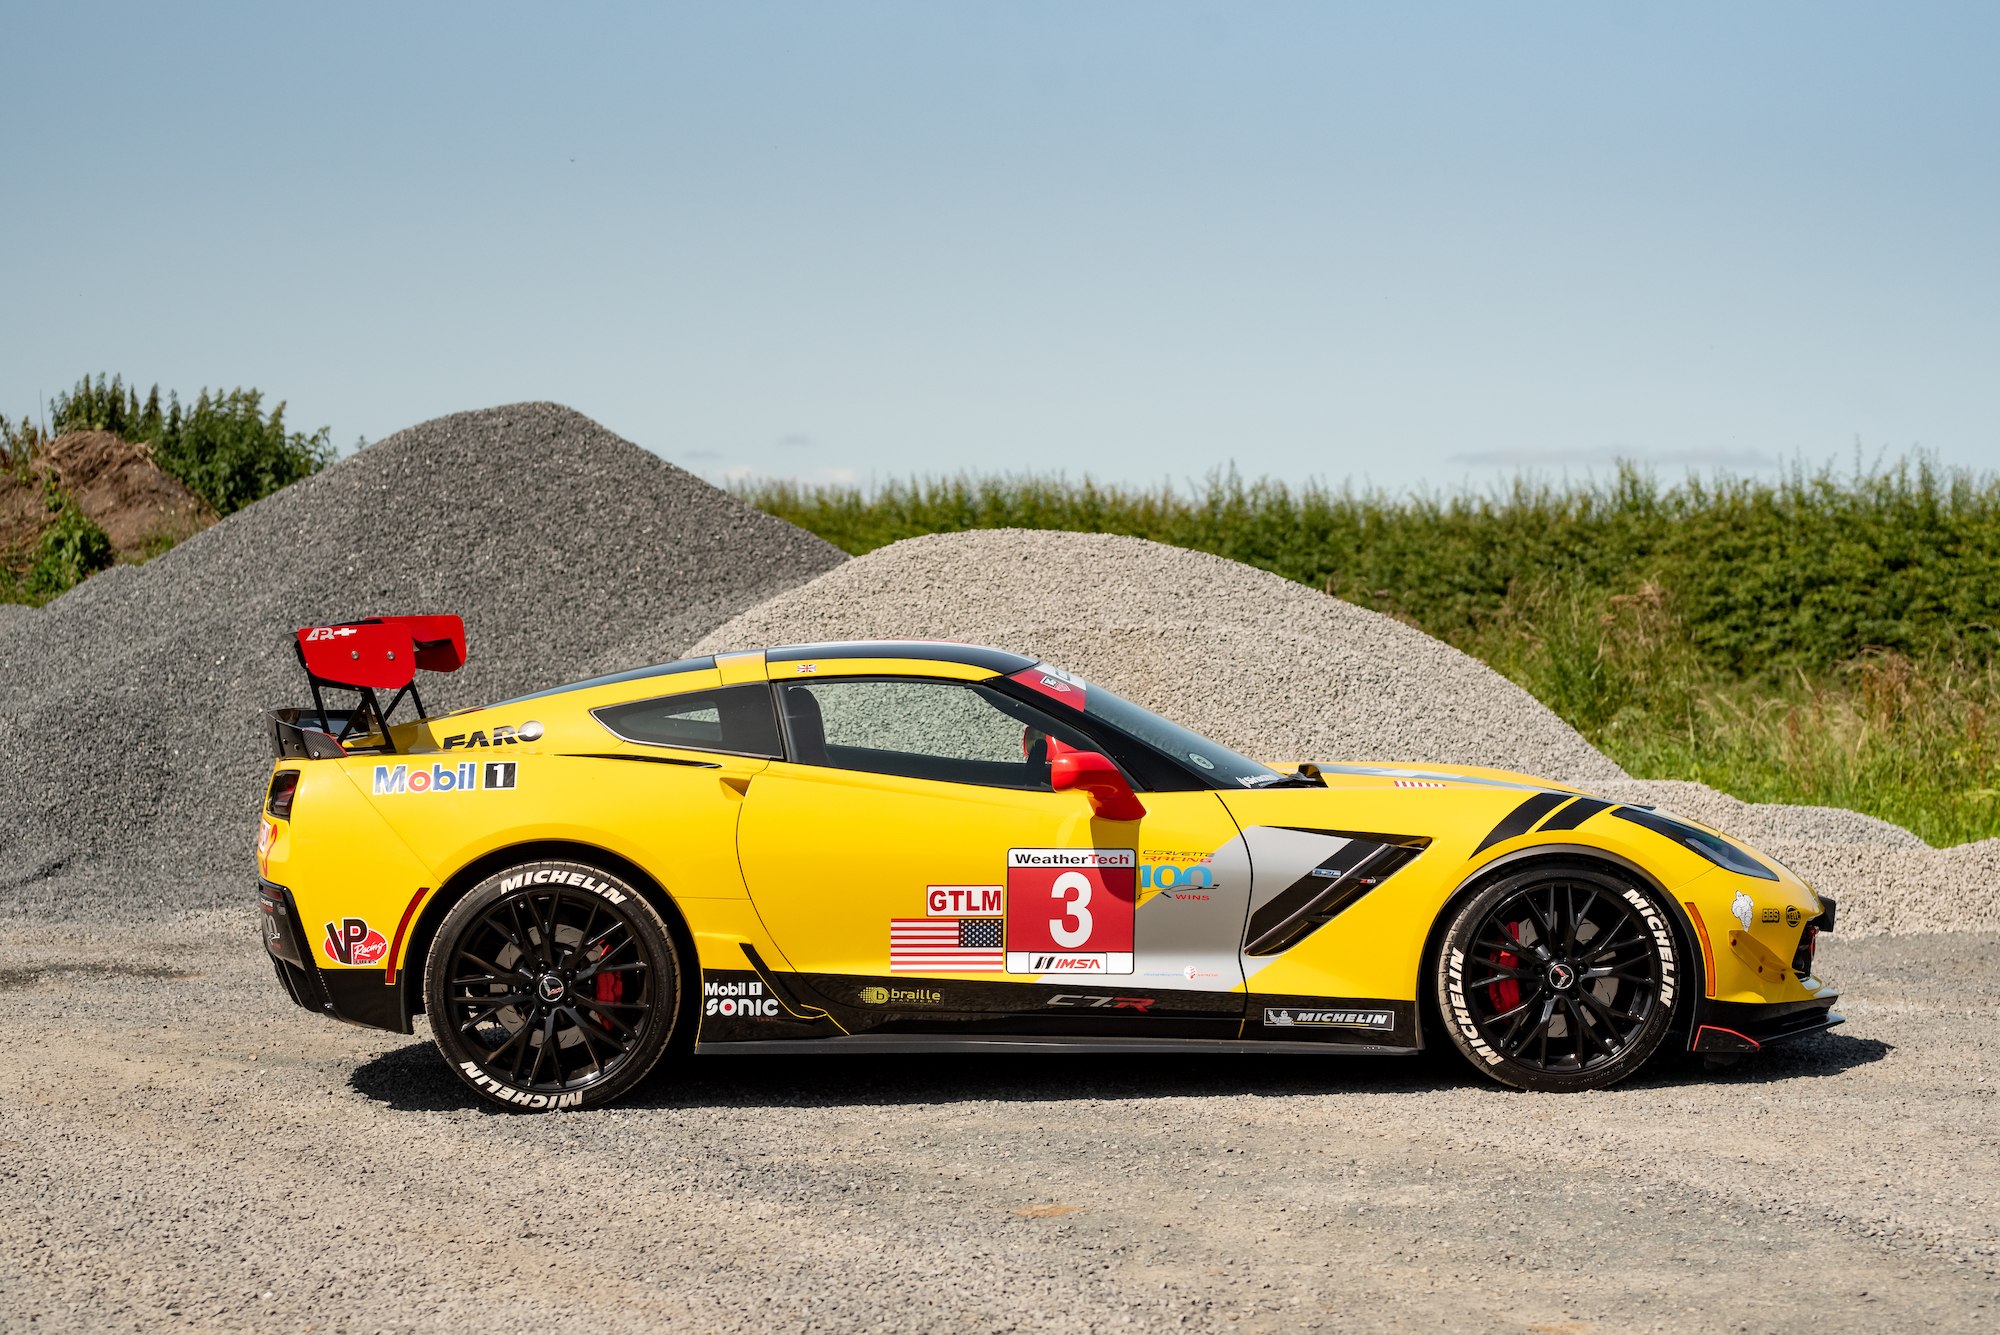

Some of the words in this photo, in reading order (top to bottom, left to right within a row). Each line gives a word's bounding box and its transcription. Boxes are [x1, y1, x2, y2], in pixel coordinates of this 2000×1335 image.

[443, 720, 545, 750] FARO
[374, 763, 476, 794] Mobil
[1015, 854, 1129, 864] WeatherTech
[501, 870, 627, 904] MICHELIN
[1138, 865, 1212, 888] 100
[929, 890, 1001, 912] GTLM
[1049, 871, 1093, 949] 3
[1762, 908, 1780, 923] BBS
[326, 919, 367, 964] VP
[354, 941, 386, 959] Racing
[1623, 889, 1675, 1008] MICHELIN
[1055, 959, 1100, 969] IMSA
[705, 982, 746, 996] Mobil
[891, 988, 940, 1000] braille
[1296, 1012, 1388, 1024] MICHELIN
[1449, 947, 1504, 1066] MICHELIN
[460, 1061, 584, 1108] MICHELIN
